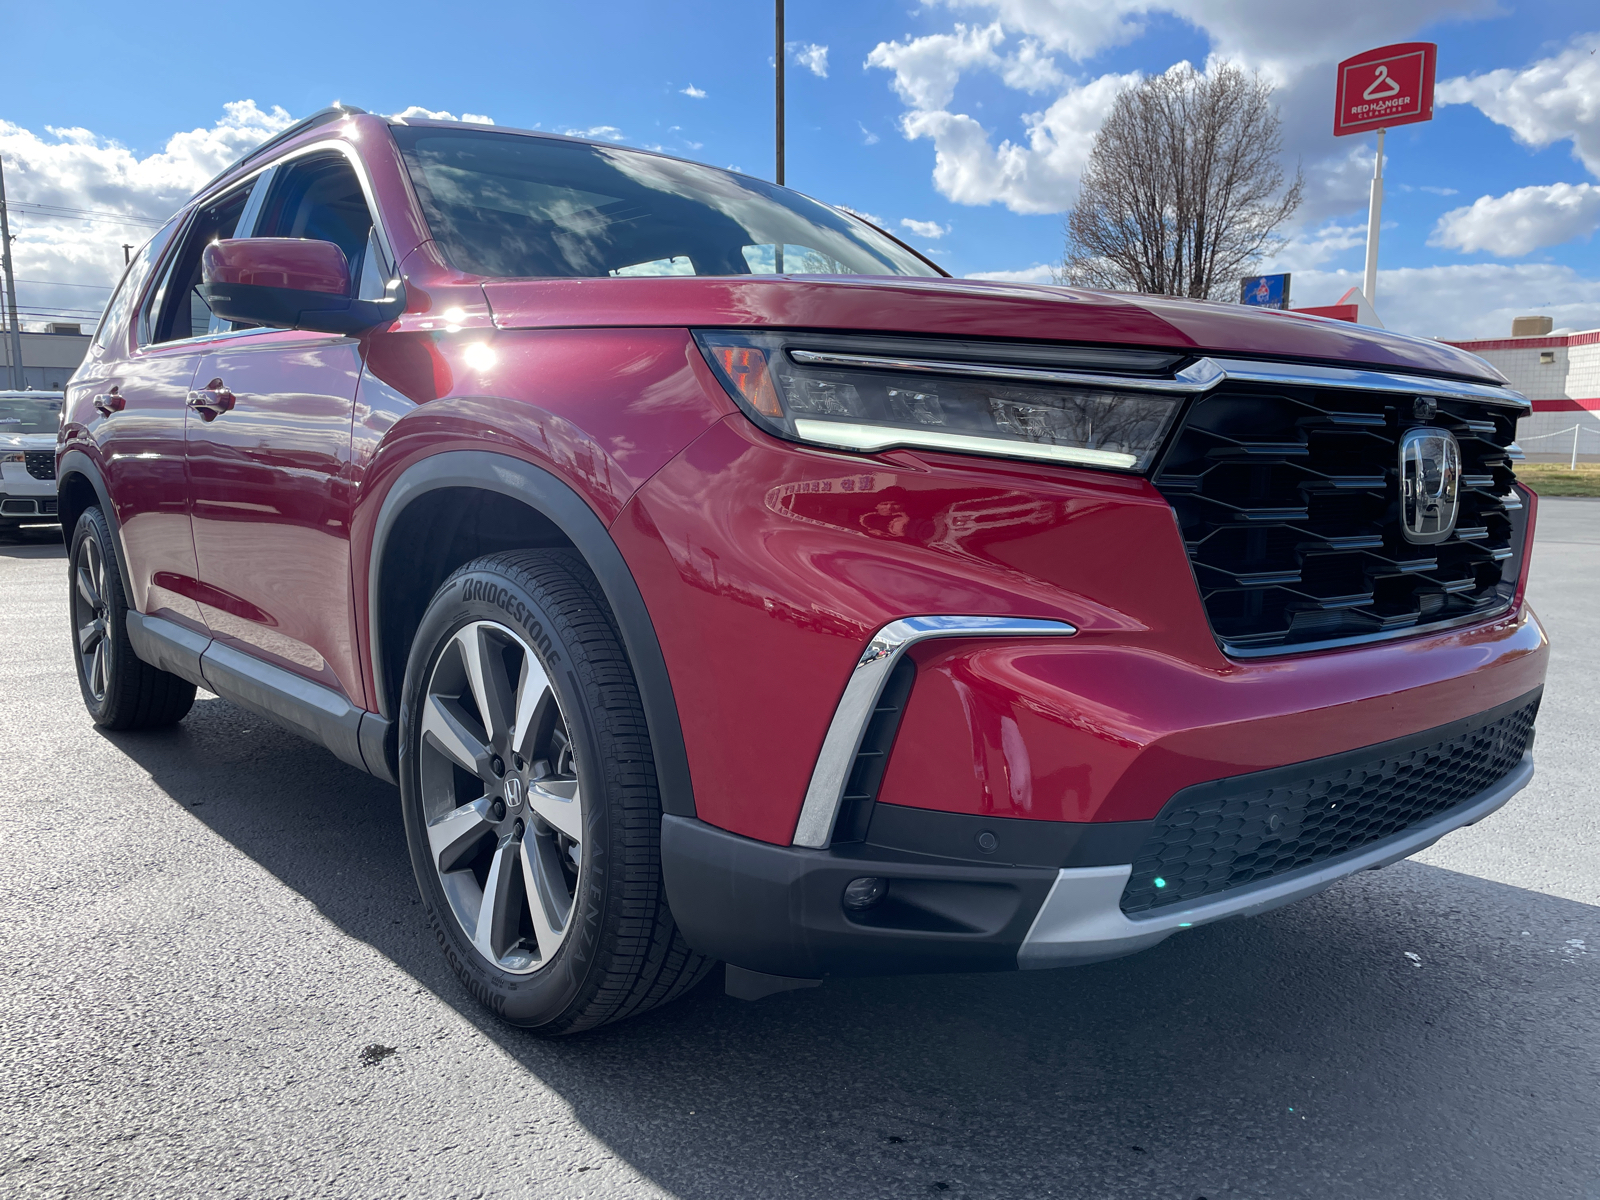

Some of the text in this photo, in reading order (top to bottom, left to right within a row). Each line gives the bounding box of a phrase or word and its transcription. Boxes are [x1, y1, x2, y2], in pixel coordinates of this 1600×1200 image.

[1351, 105, 1369, 114] RED
[1358, 106, 1401, 118] CLEANERS
[462, 577, 562, 671] BRIDGESTONE
[574, 839, 604, 962] ALENZA
